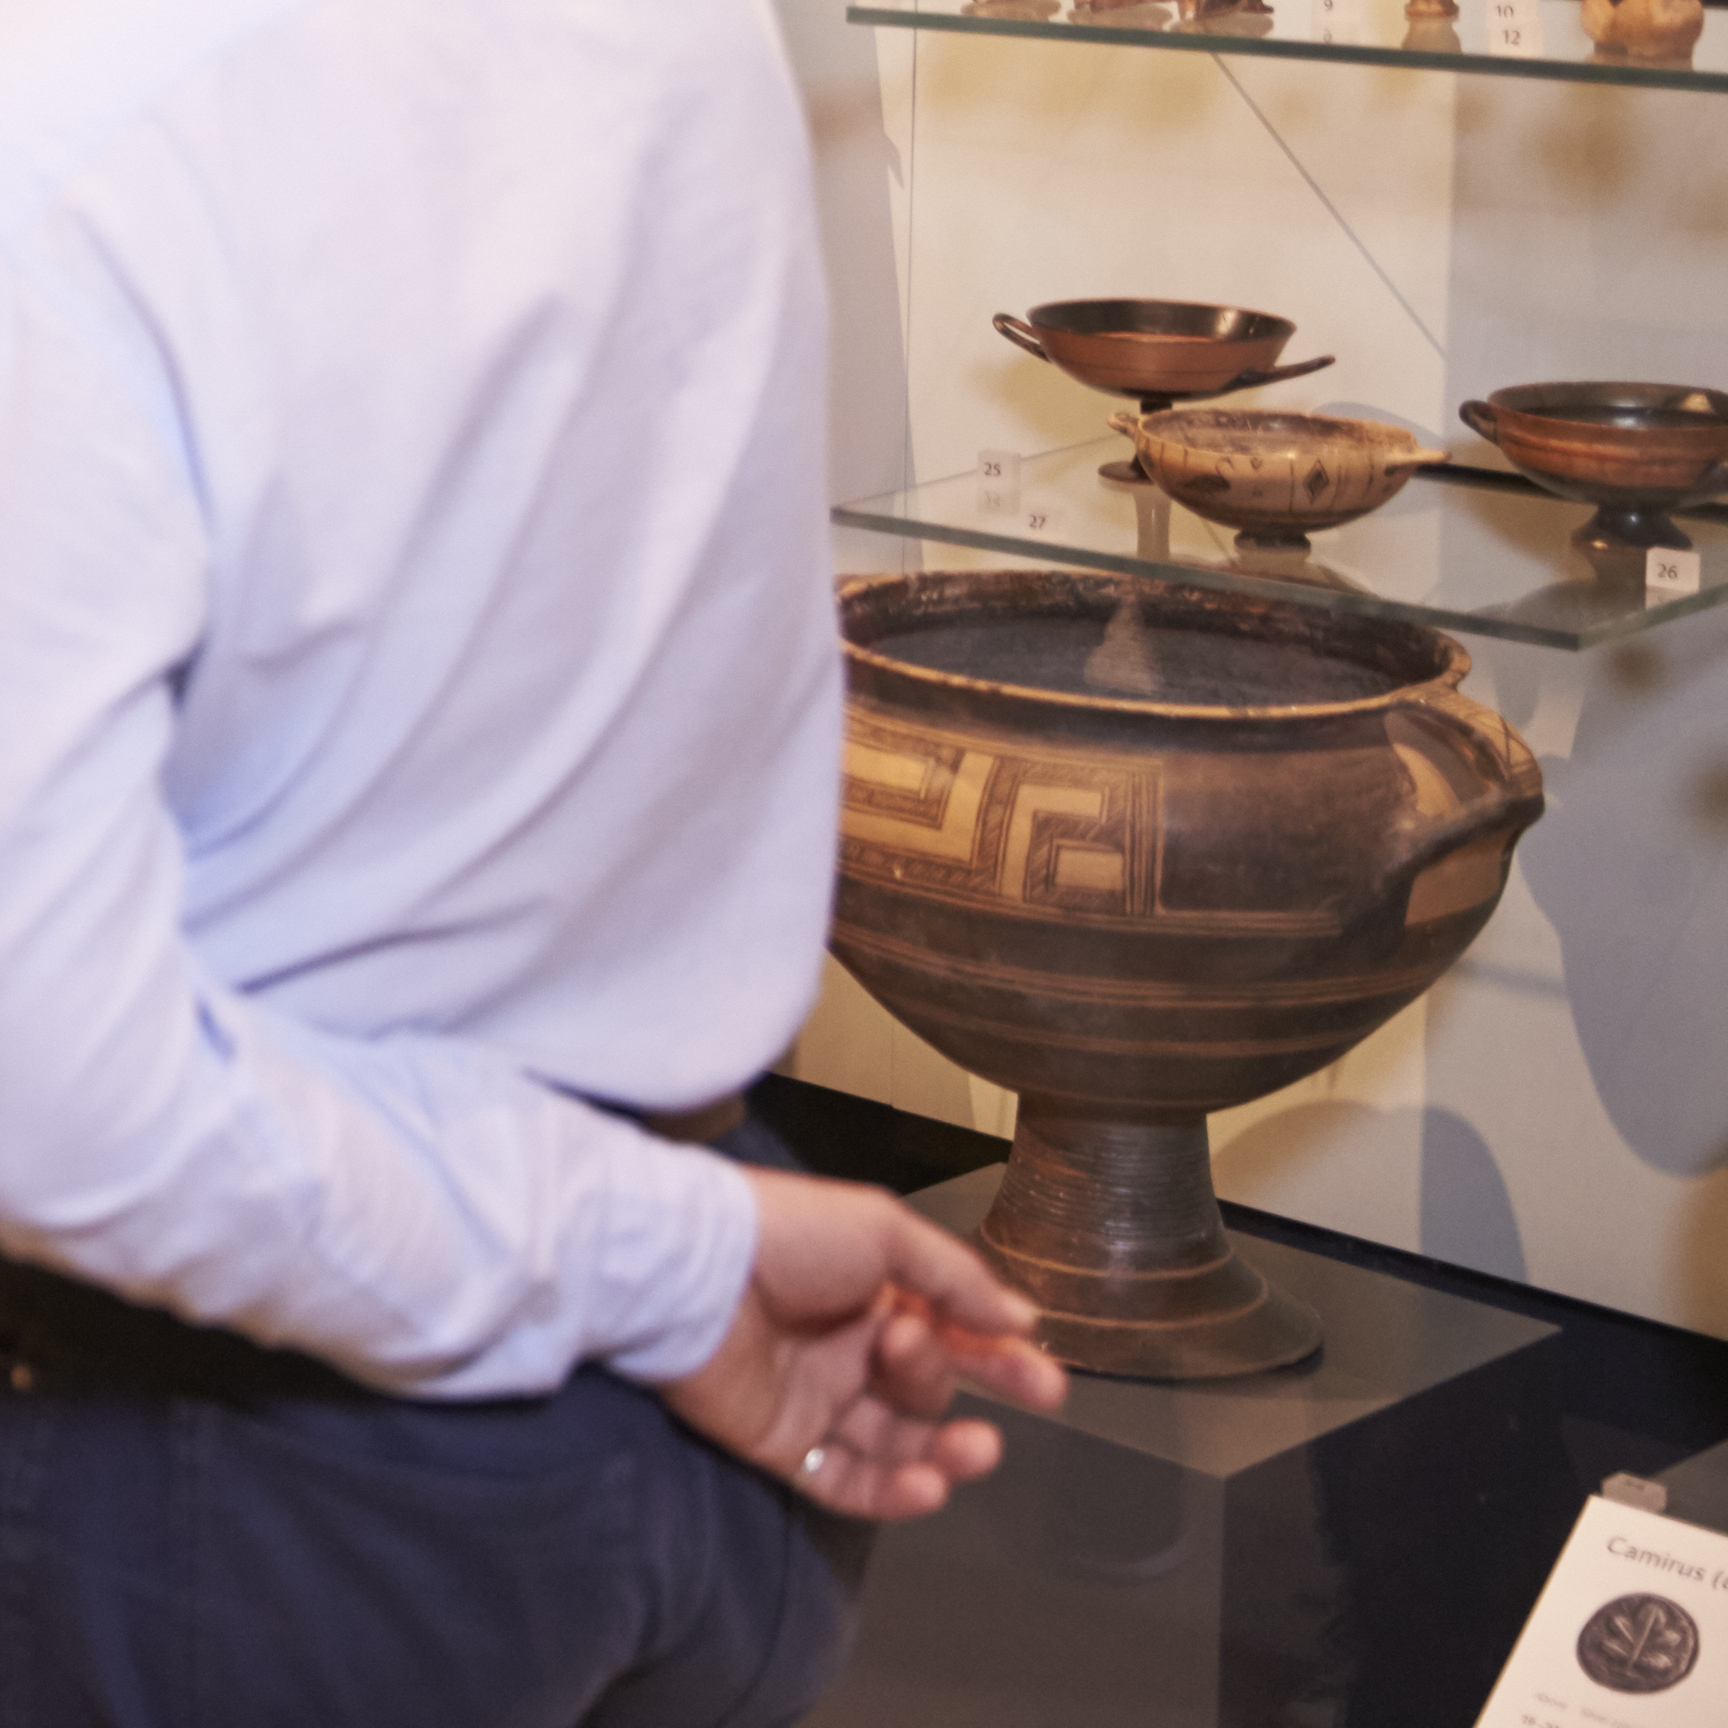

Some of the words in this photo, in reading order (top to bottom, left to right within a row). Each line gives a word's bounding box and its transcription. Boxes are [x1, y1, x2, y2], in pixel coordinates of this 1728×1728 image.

[1496, 5, 1514, 17] 10
[1503, 29, 1521, 45] 12
[985, 462, 1001, 476] 25
[1030, 514, 1046, 528] 27
[1658, 563, 1678, 579] 26
[1606, 1536, 1706, 1582] Camirus
